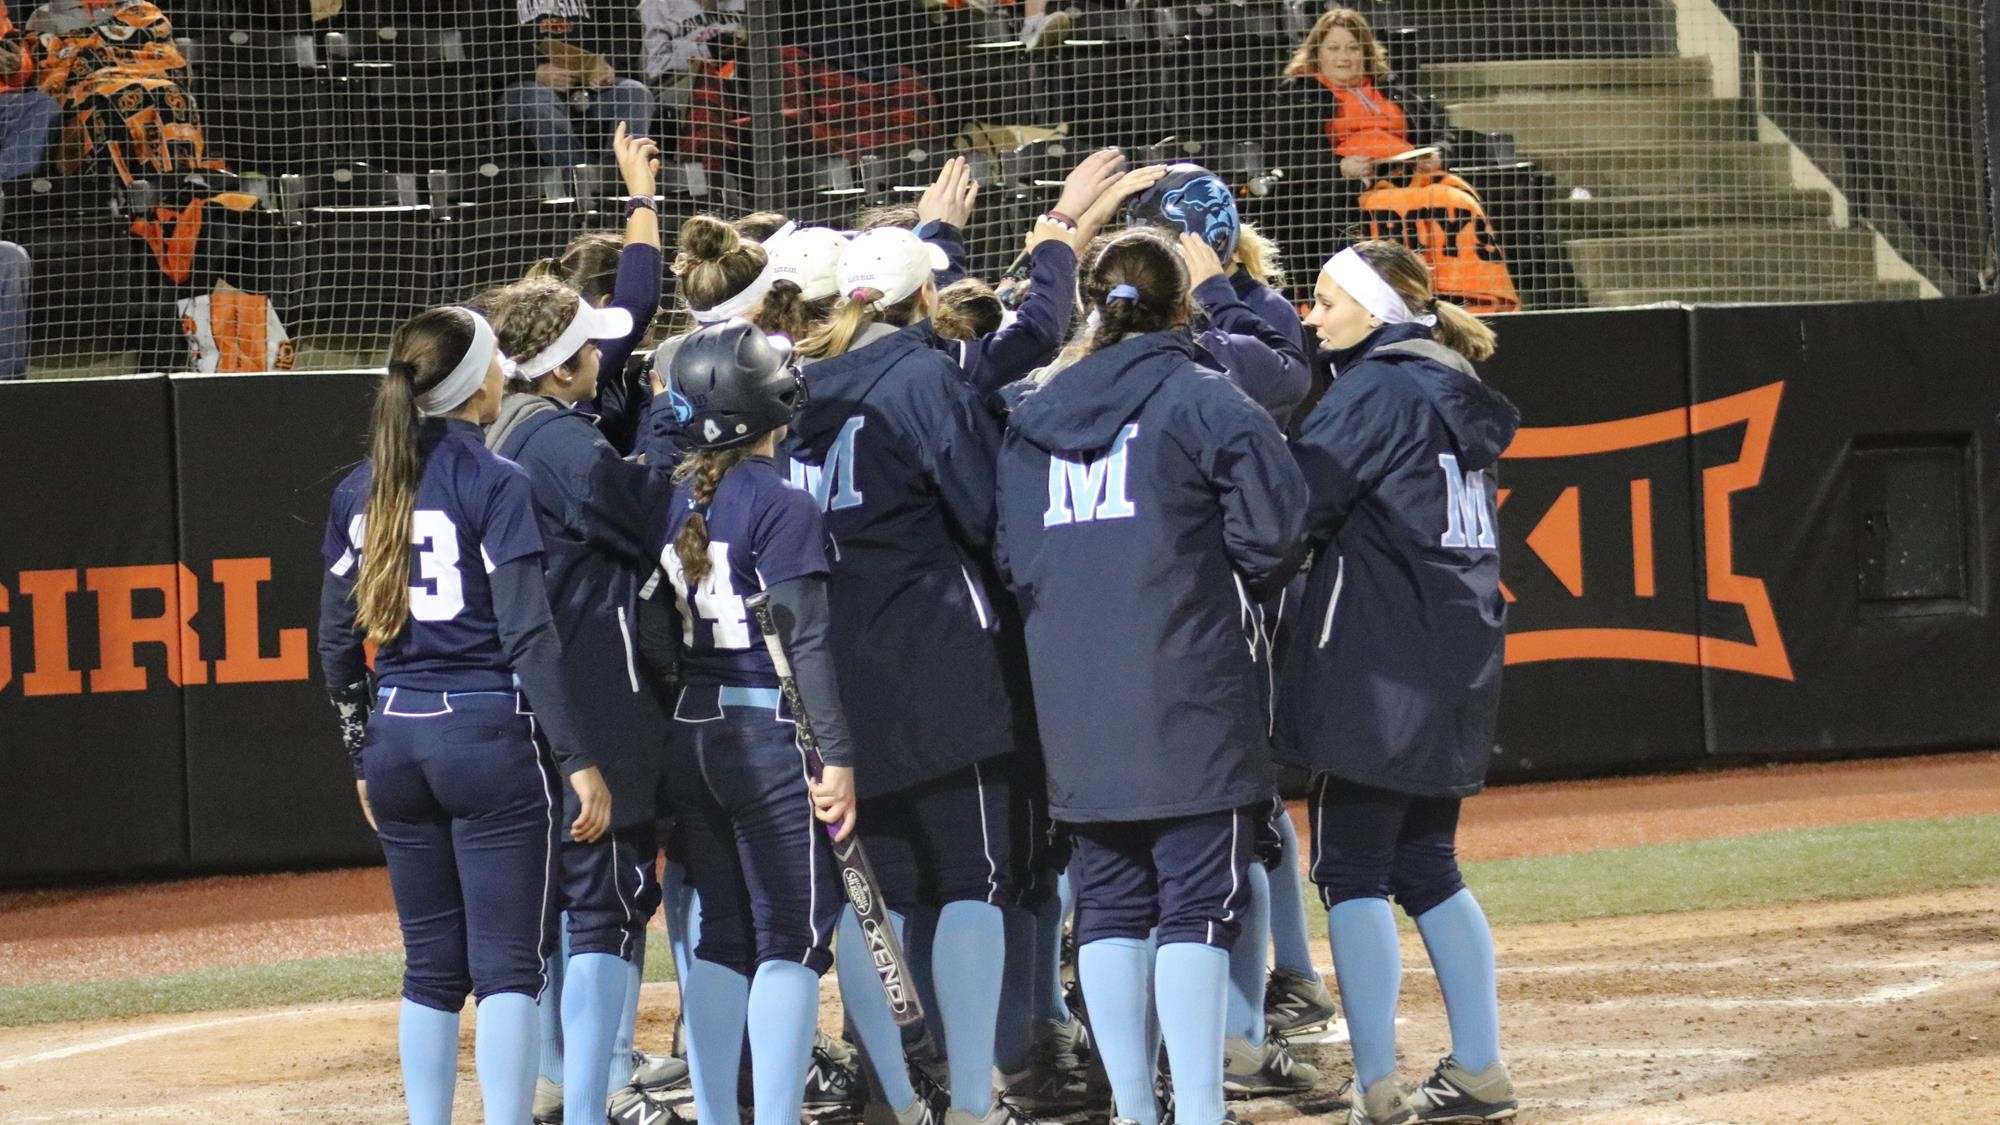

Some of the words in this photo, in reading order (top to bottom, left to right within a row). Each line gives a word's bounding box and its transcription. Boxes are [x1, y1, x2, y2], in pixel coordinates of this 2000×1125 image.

[1043, 423, 1139, 528] M
[1438, 453, 1496, 548] M
[0, 557, 309, 696] IRL
[866, 926, 904, 1005] XENO
